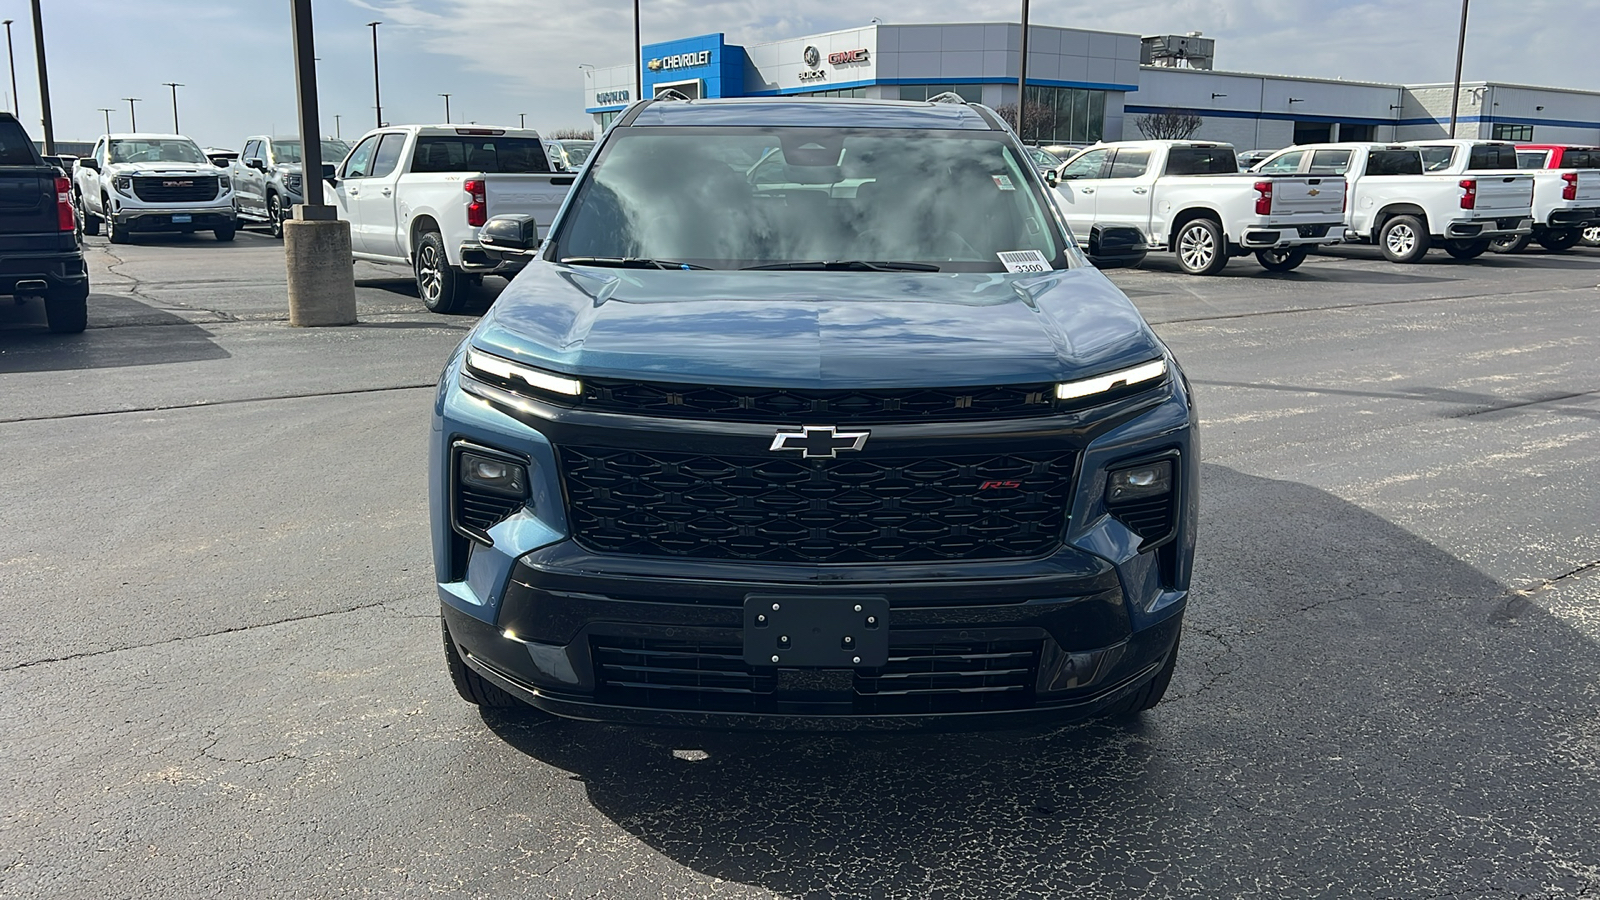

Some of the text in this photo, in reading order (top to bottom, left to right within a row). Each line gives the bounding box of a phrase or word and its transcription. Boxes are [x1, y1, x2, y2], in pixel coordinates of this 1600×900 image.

[663, 50, 710, 69] CHEVROLET
[828, 49, 868, 64] GMC
[799, 70, 825, 80] BUICK
[1015, 264, 1043, 273] 3300
[979, 481, 1020, 490] RS
